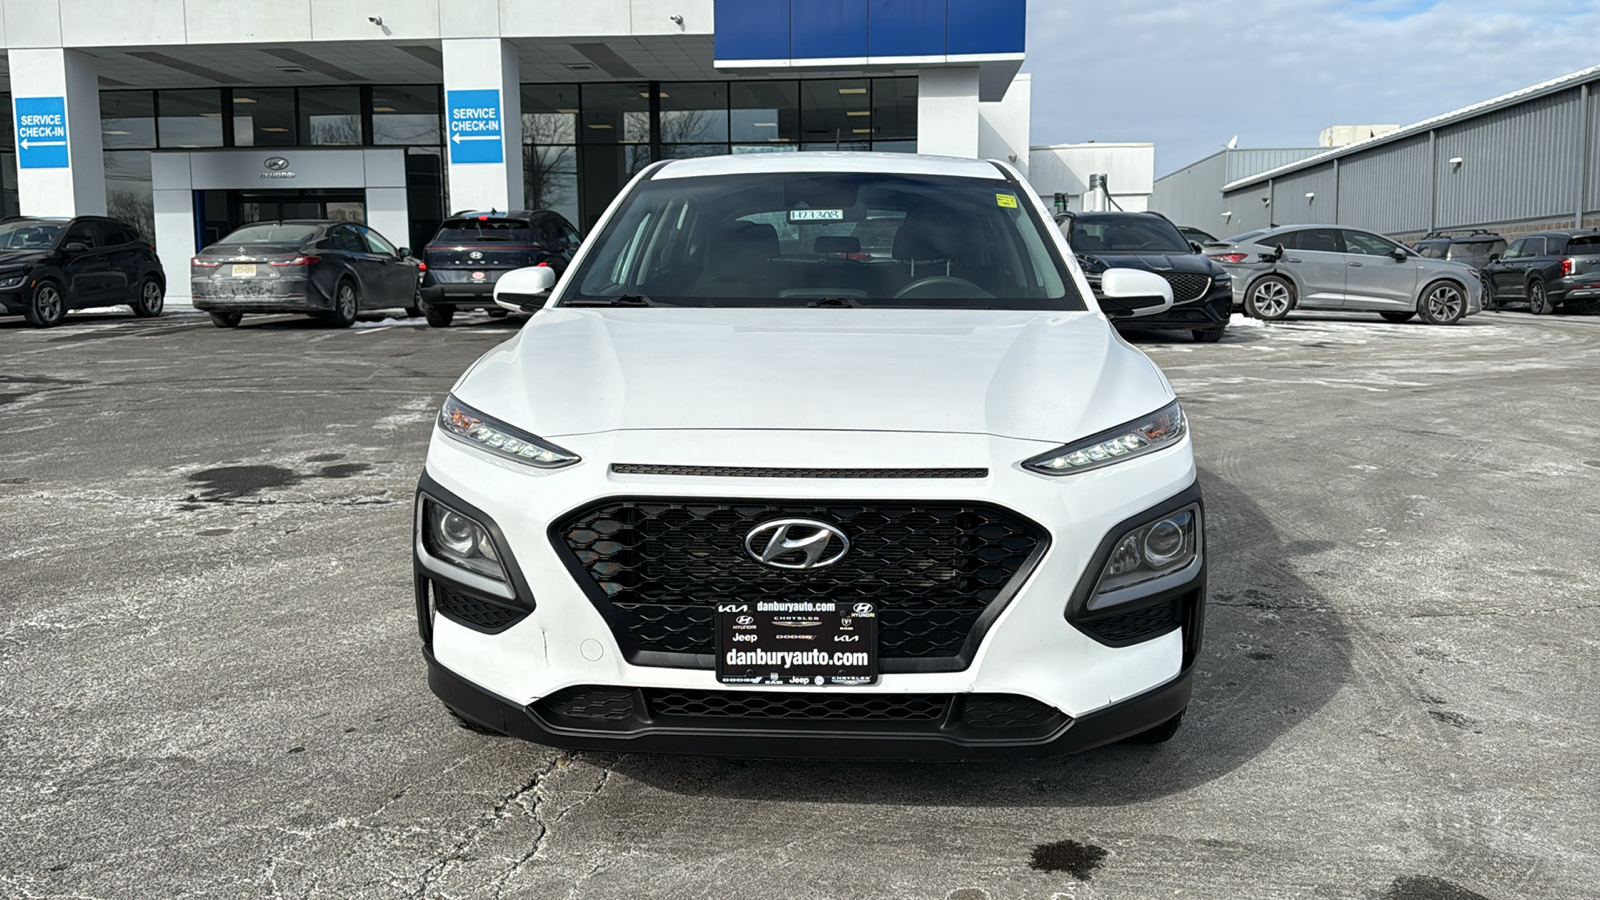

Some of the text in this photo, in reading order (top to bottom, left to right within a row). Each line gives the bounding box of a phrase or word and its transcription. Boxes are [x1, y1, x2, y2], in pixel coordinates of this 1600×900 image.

[453, 107, 496, 119] SERVICE
[21, 114, 62, 126] SERVICE
[451, 120, 499, 132] CHECK-IN
[19, 126, 65, 138] CHECK-IN
[259, 171, 296, 179] HYUNDAI
[757, 601, 836, 613] danburyauto.com
[732, 632, 758, 643] Jeep
[726, 648, 869, 669] danburyauto.com
[788, 675, 810, 685] Jeep
